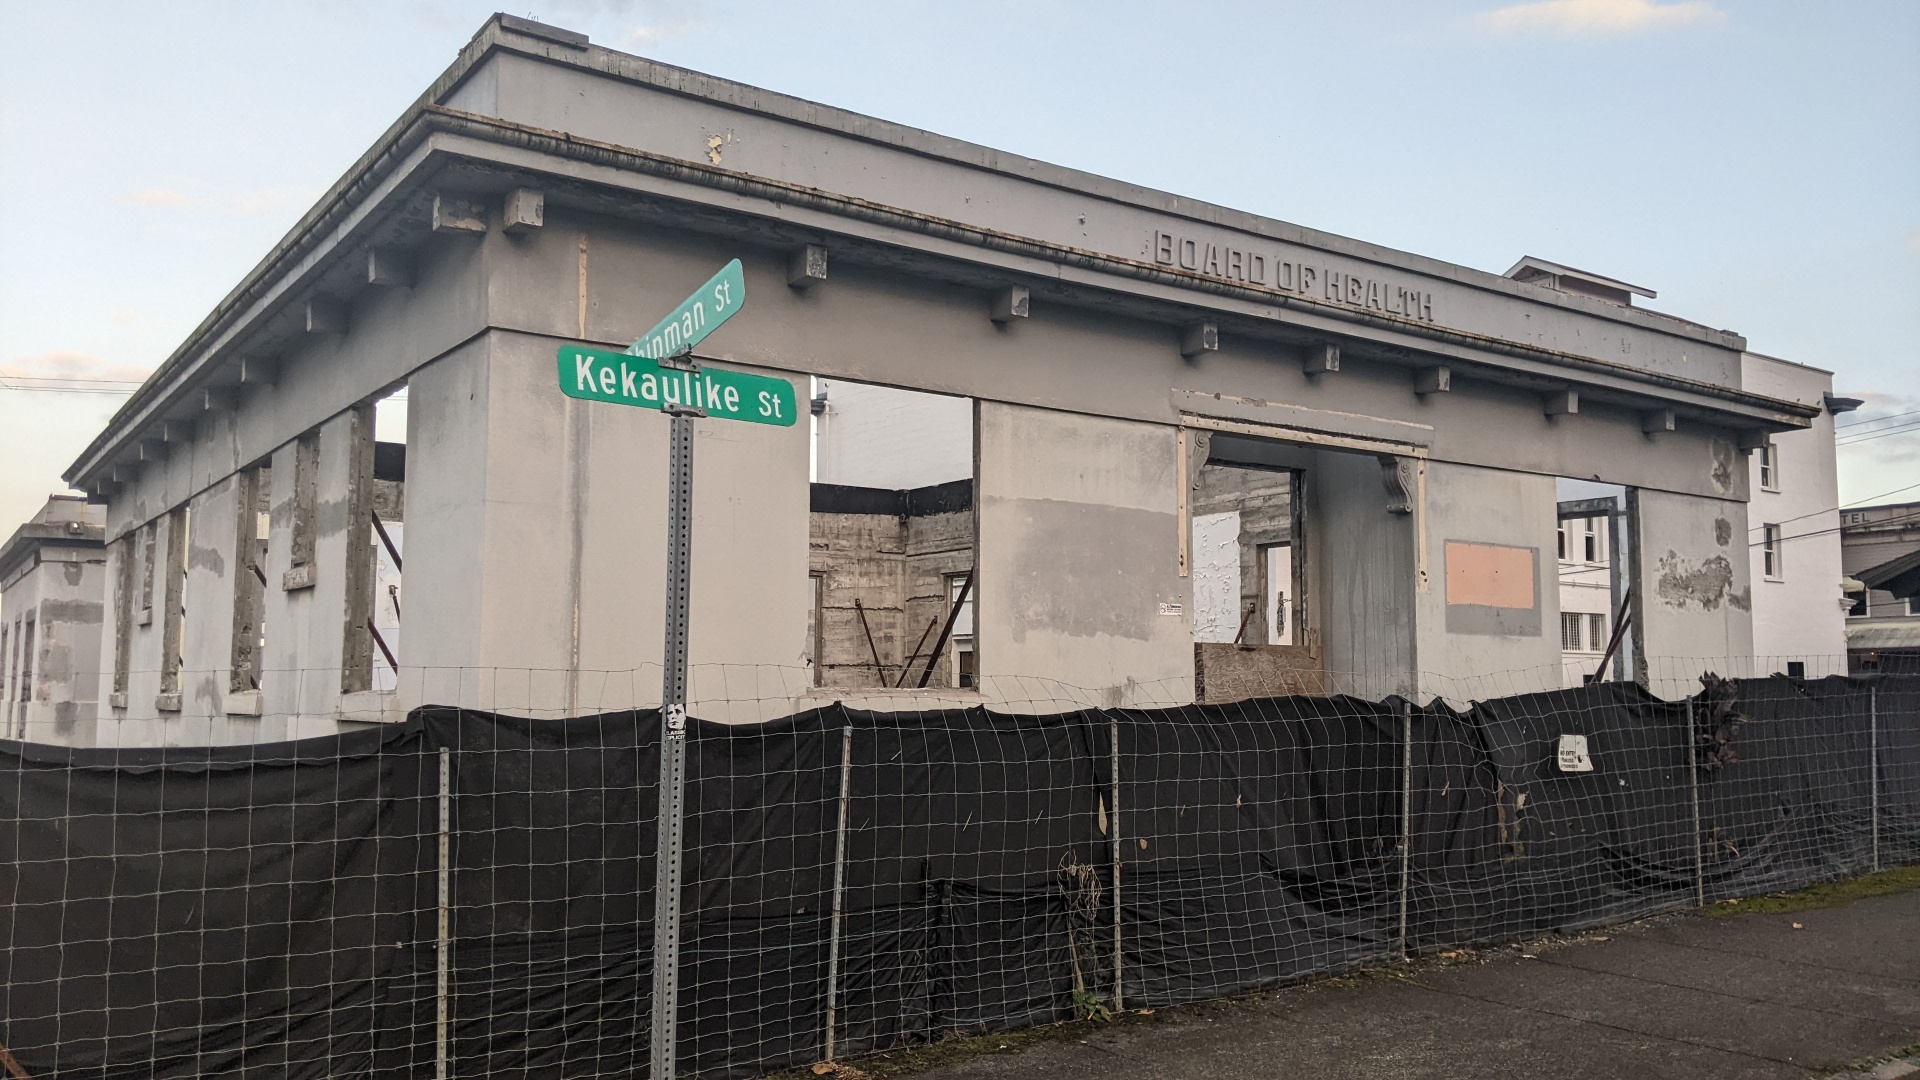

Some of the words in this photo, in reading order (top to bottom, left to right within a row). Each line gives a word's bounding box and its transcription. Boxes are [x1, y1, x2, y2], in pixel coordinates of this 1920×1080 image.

[1155, 229, 1267, 285] BOARD
[1277, 258, 1316, 294] OF
[1324, 268, 1435, 322] HEALTH
[626, 301, 705, 359] ipman
[714, 279, 732, 312] St
[575, 353, 740, 413] Kekaulike
[758, 391, 782, 418] St
[1841, 512, 1870, 524] TEL
